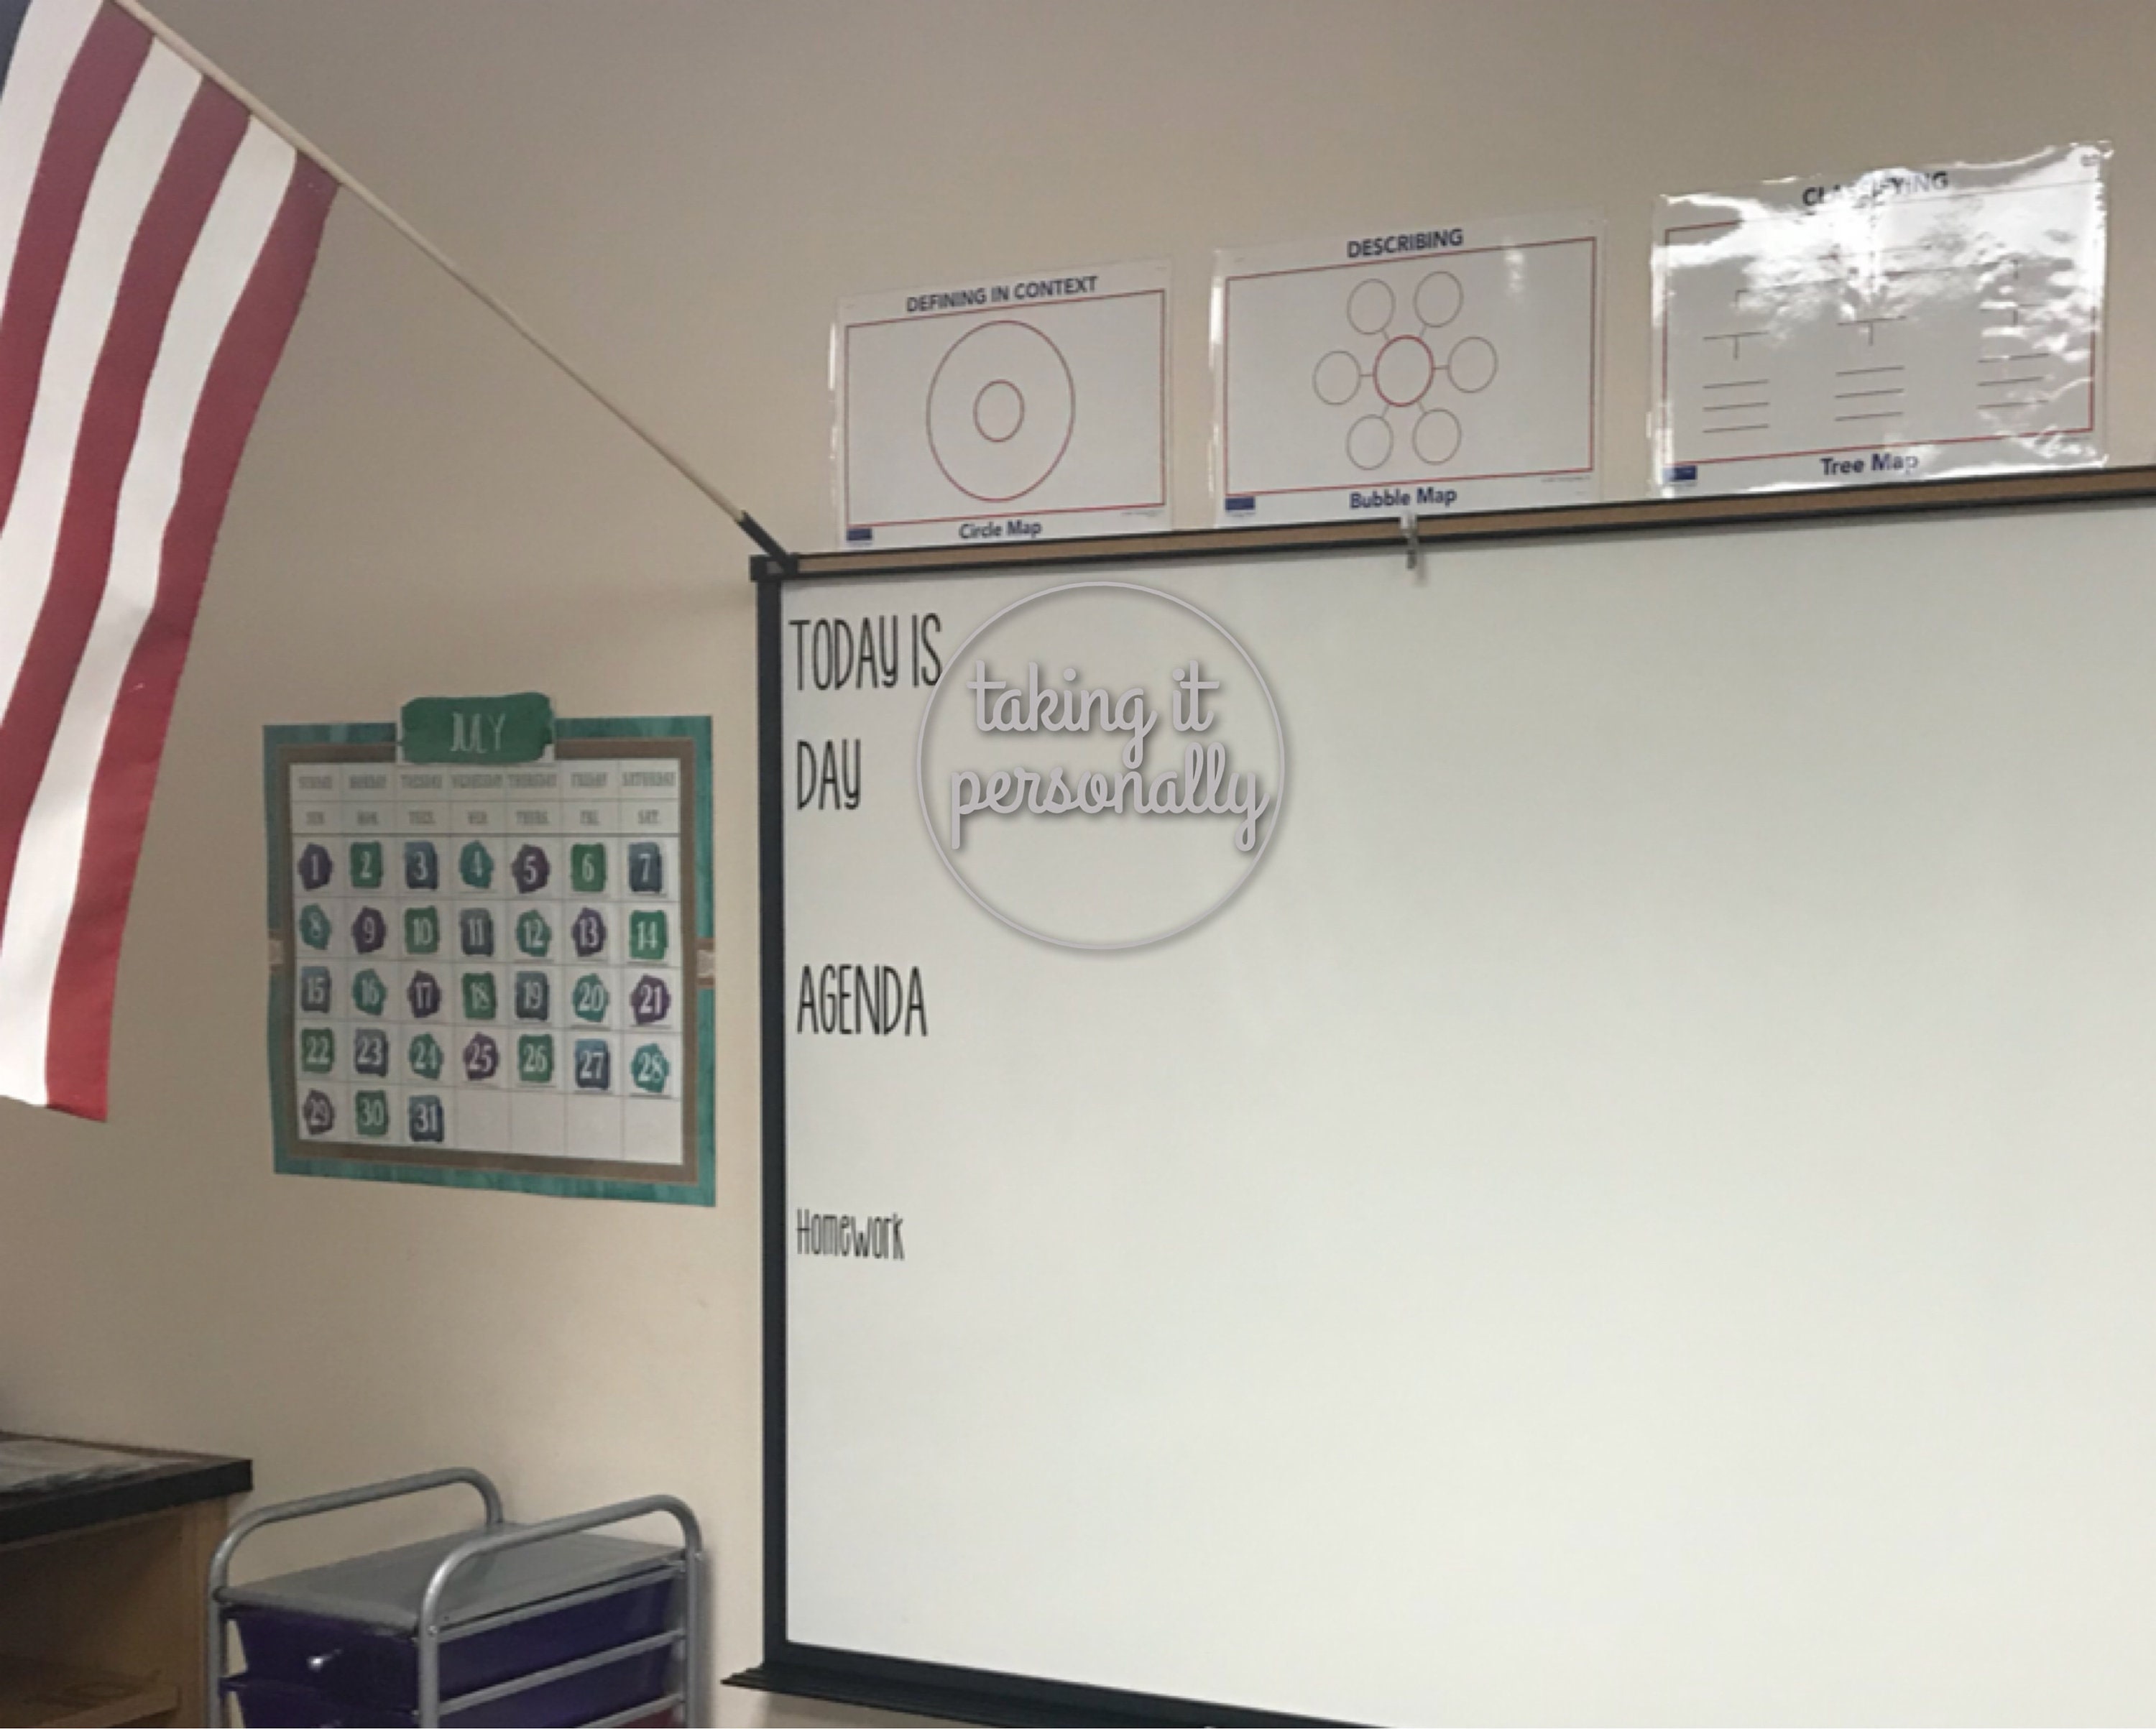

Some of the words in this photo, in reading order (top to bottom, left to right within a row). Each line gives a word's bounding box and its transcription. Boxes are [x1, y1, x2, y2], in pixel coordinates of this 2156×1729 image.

[1347, 229, 1465, 258] DESCRIBING
[906, 287, 987, 313] DEFINING
[991, 285, 1010, 303] IN
[1014, 276, 1099, 300] CONTEXT
[1820, 456, 1865, 476] Tree
[1871, 453, 1920, 476] Map
[1350, 489, 1411, 510] Bubble
[1417, 487, 1458, 509] Map
[959, 522, 1003, 539] Circle
[1007, 519, 1043, 539] Map
[788, 614, 898, 691] TODAY
[911, 612, 942, 688] IS
[797, 738, 862, 811] DAY
[311, 853, 320, 880] 1
[359, 851, 373, 878] 2
[415, 851, 428, 880] 3
[471, 851, 484, 878] 4
[524, 855, 537, 885] 5
[581, 853, 595, 882] 6
[637, 853, 650, 882] 7
[363, 916, 376, 944] 9
[413, 917, 432, 946] 10
[469, 918, 485, 946] 11
[523, 918, 544, 949] 12
[579, 916, 600, 949] 13
[637, 921, 658, 951] 14
[306, 977, 323, 1005] 15
[361, 977, 380, 1005] 16
[415, 981, 432, 1009] 17
[471, 982, 490, 1010] 18
[523, 981, 542, 1010] 19
[579, 982, 604, 1012] 20
[638, 984, 663, 1014] 21
[796, 963, 929, 1037] AGENDA
[306, 1036, 330, 1065] 22
[356, 1036, 382, 1066] 23
[413, 1041, 438, 1070] 24
[469, 1043, 493, 1071] 25
[522, 1043, 548, 1073] 26
[579, 1050, 605, 1079] 27
[637, 1051, 664, 1082] 28
[309, 1099, 328, 1126] 29
[361, 1099, 384, 1127] 30
[414, 1103, 438, 1133] 31
[796, 1207, 906, 1261] Homework
